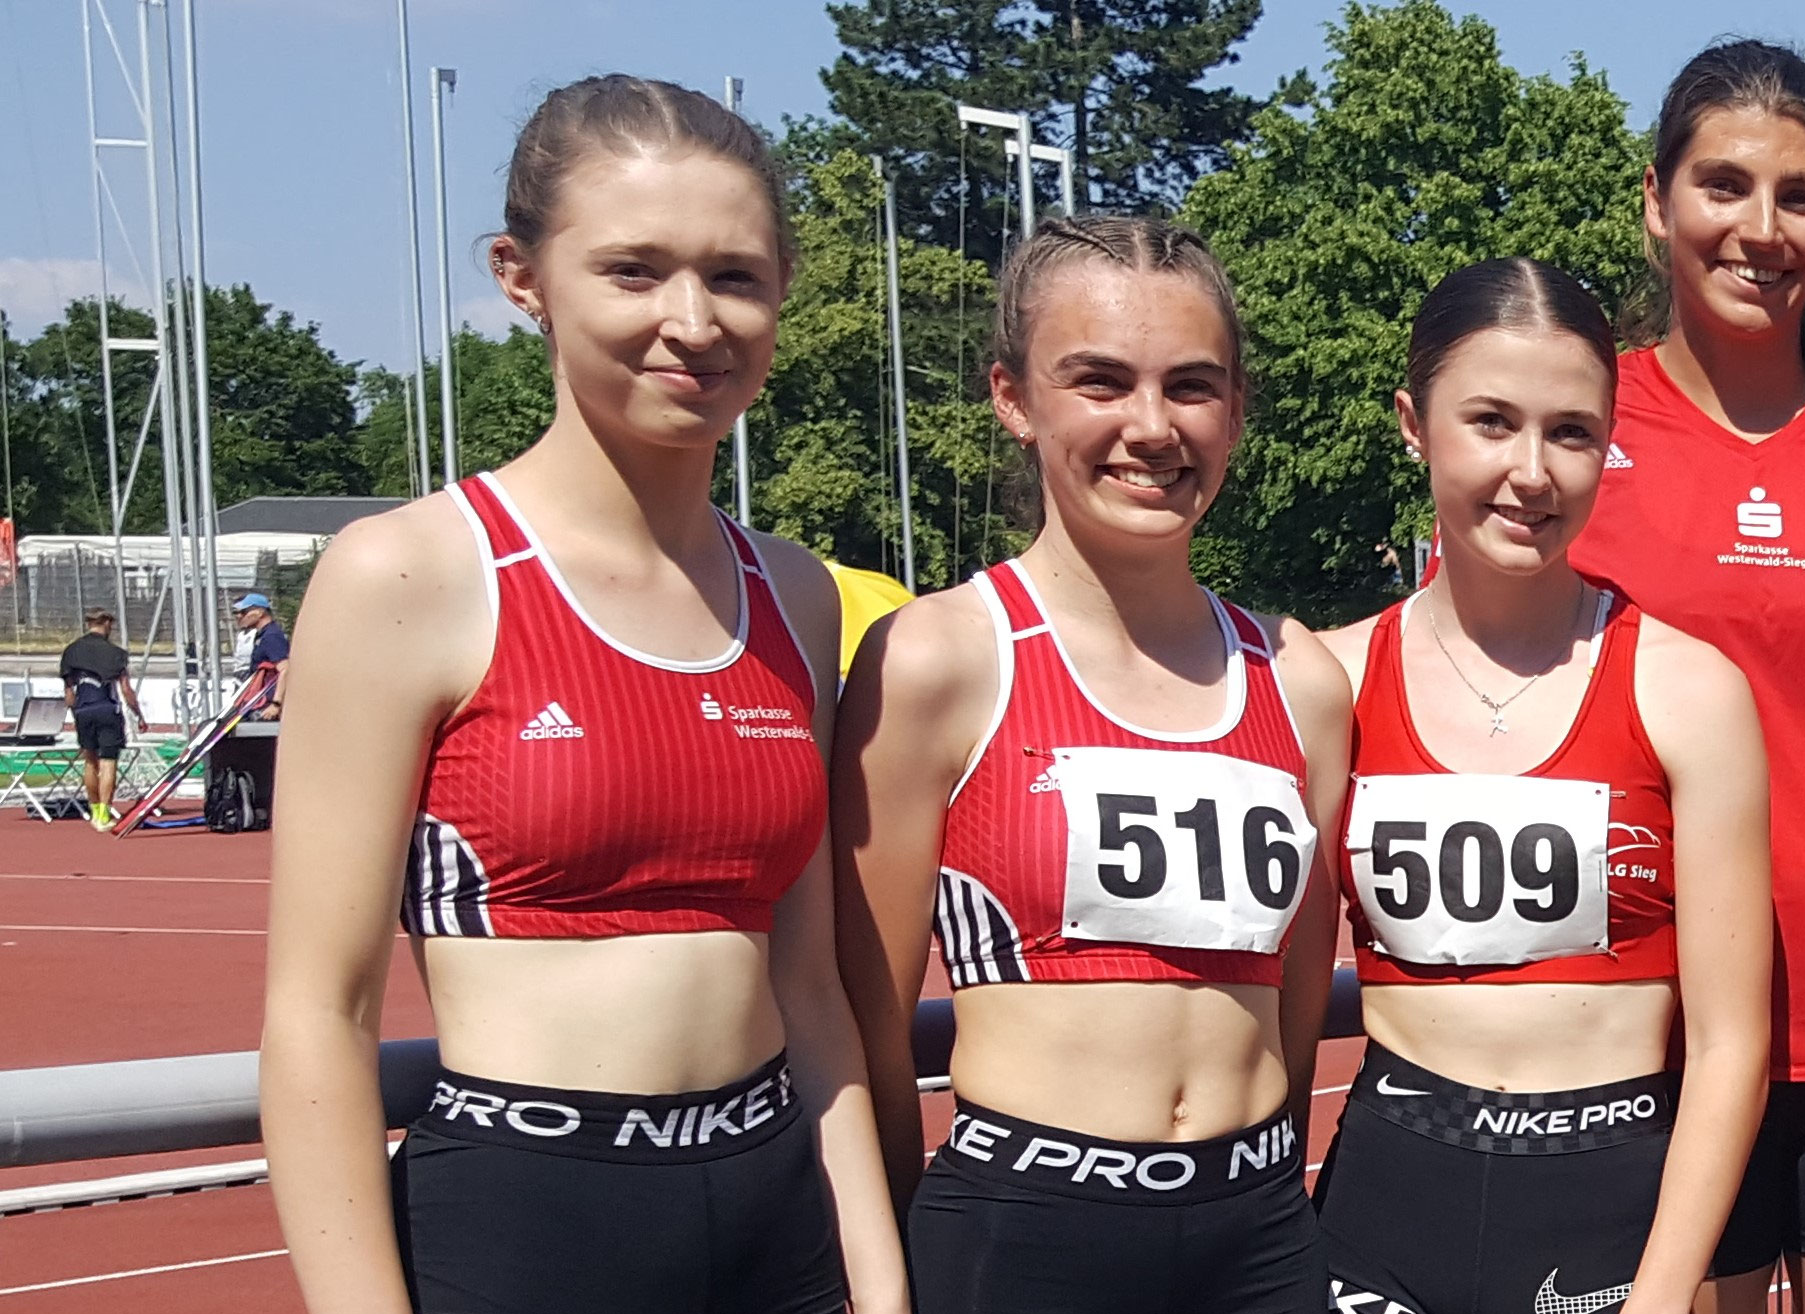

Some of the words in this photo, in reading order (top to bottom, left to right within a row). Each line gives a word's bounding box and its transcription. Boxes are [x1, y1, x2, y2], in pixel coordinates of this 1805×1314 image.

[1734, 542, 1789, 555] Sparkasse
[520, 726, 585, 740] adidas
[728, 705, 793, 722] Sparkasse
[1095, 793, 1300, 910] 516
[1372, 821, 1579, 923] 509
[1608, 863, 1627, 877] LG
[1630, 865, 1657, 883] Sieg
[429, 1081, 581, 1137] PRO
[613, 1076, 775, 1147] NIKE
[1473, 1107, 1574, 1135] NIKE
[1580, 1094, 1656, 1131] PRO
[1012, 1137, 1196, 1191] PRO
[1228, 1112, 1297, 1180] NIK
